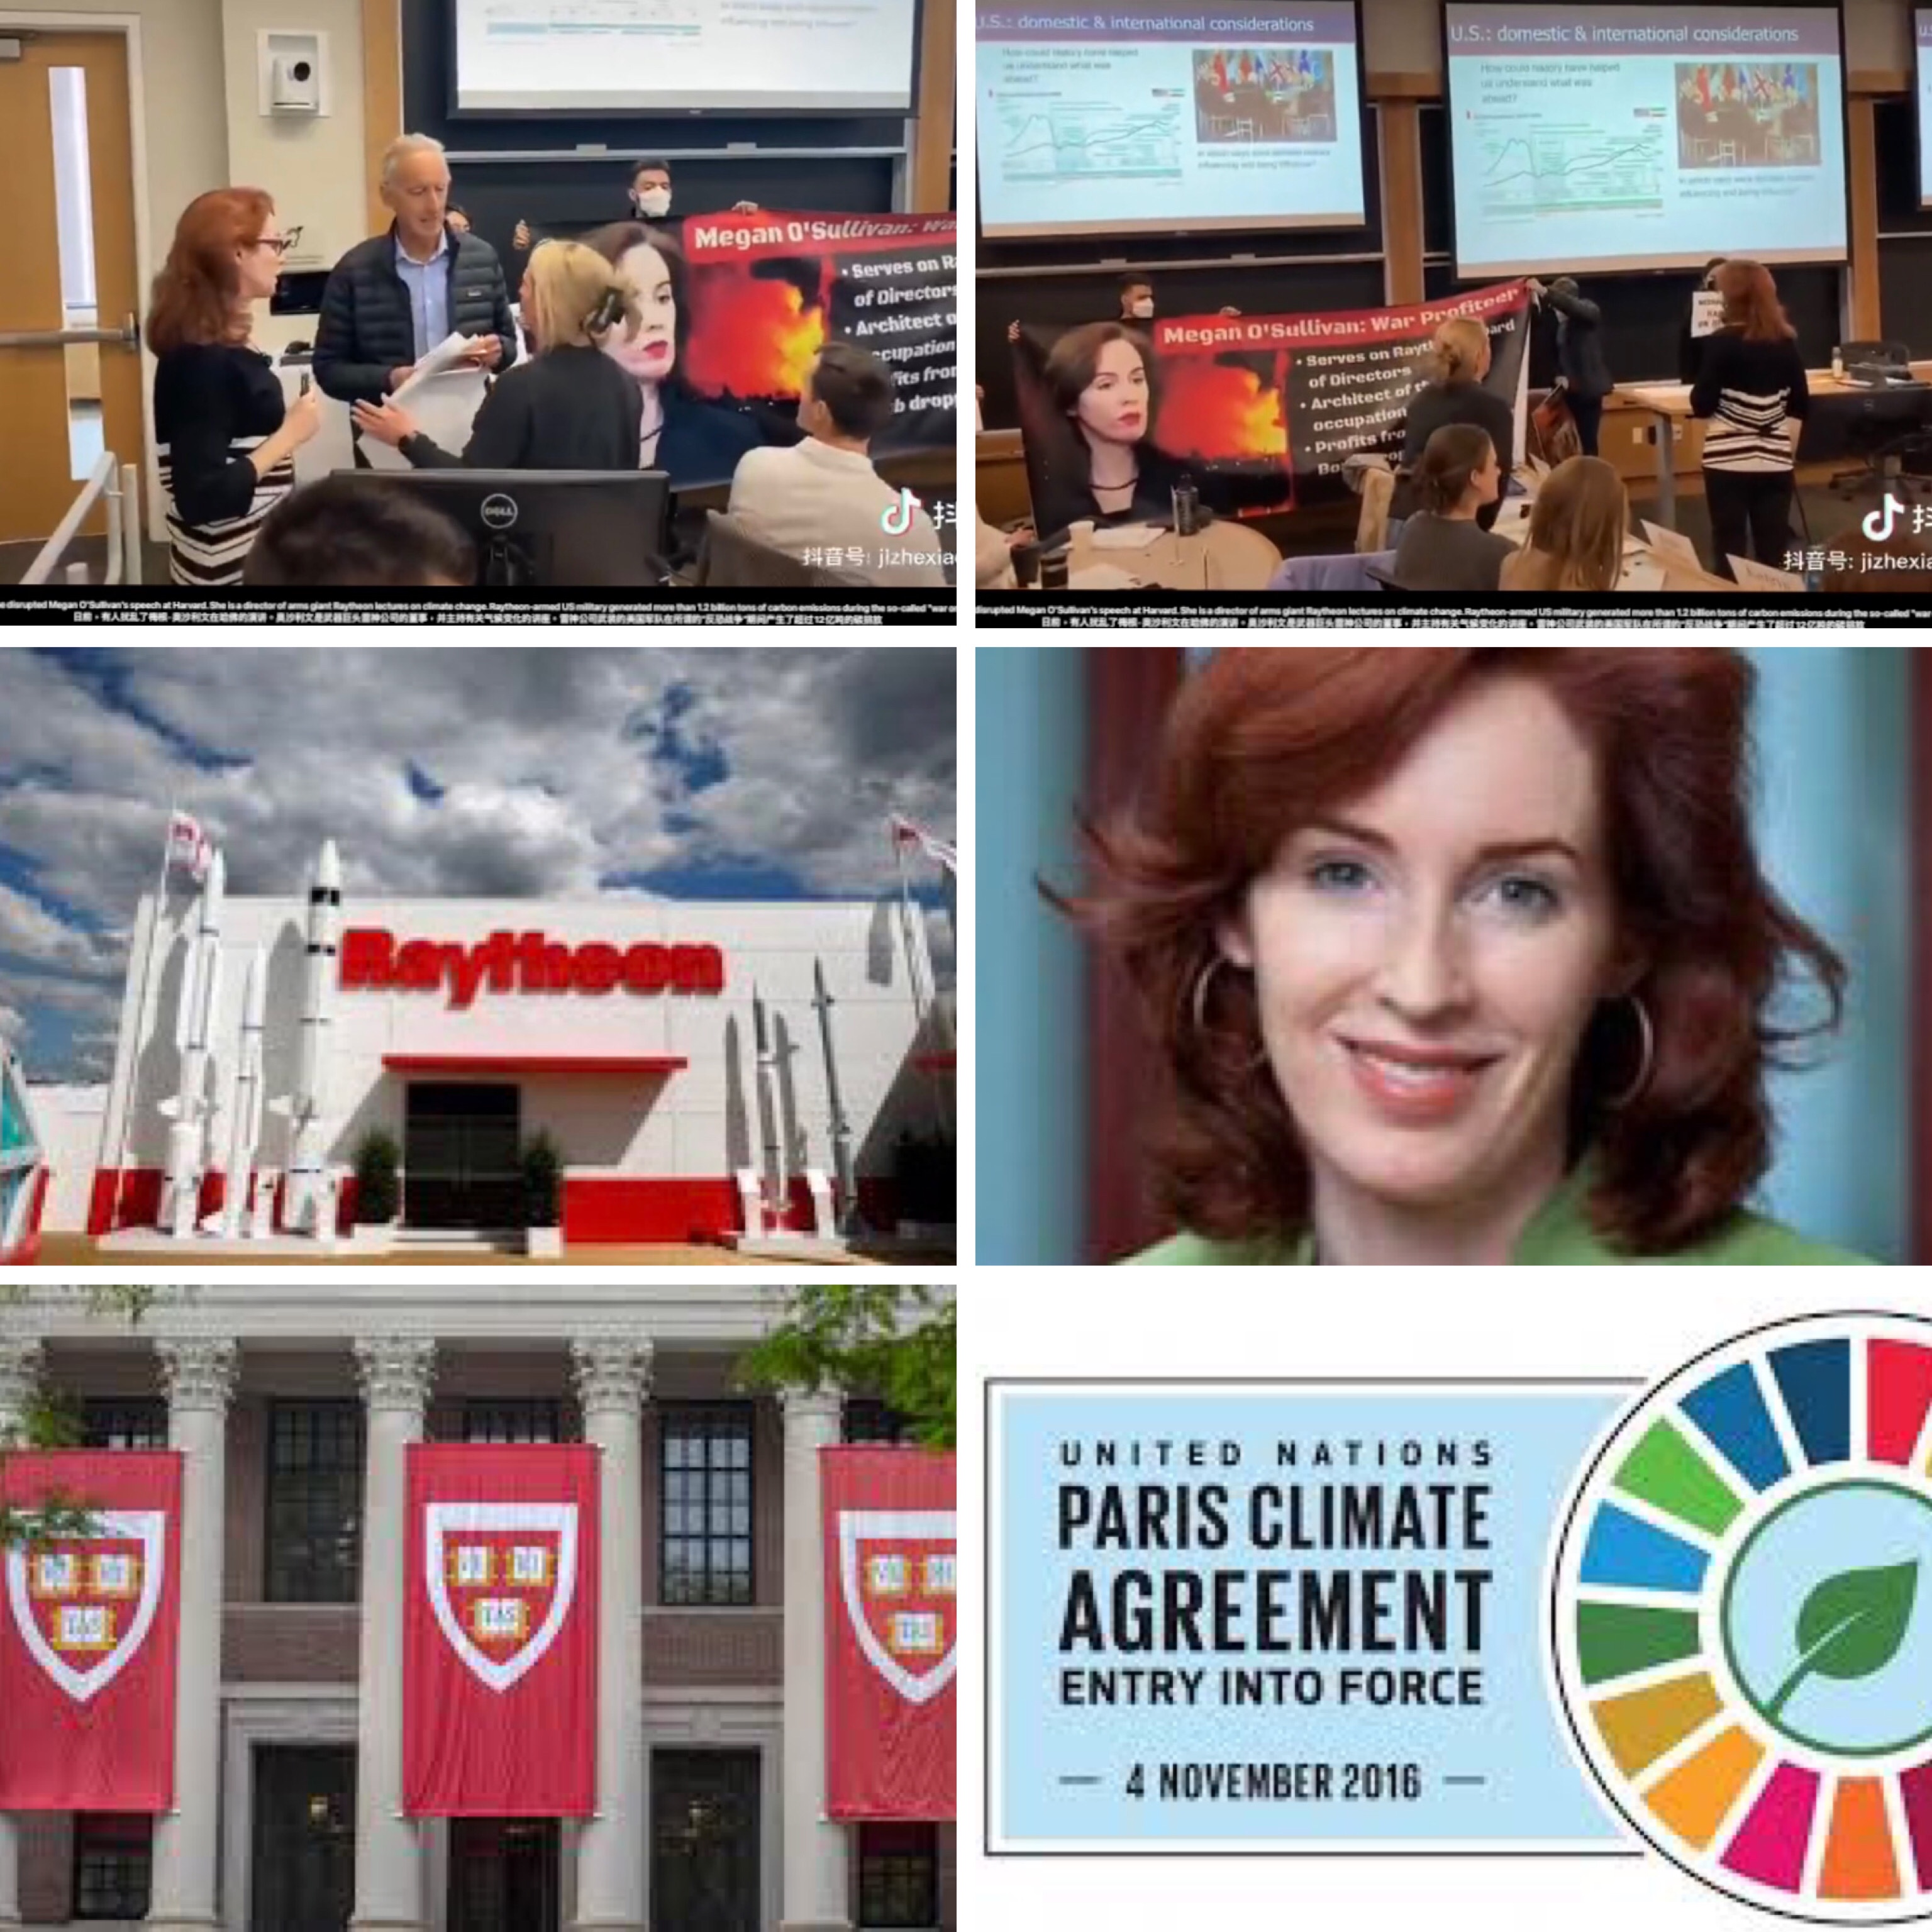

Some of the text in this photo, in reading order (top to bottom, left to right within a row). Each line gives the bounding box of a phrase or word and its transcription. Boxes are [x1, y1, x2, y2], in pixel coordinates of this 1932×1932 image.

[1018, 14, 1090, 29] domestic
[1094, 16, 1106, 29] &
[1111, 15, 1205, 30] international
[1209, 16, 1314, 31] considerations
[1450, 25, 1799, 42] U.S.: domestic & international considerations
[694, 226, 783, 250] Megan
[788, 219, 914, 243] O'Sullivan:
[852, 260, 914, 279] Serves
[916, 259, 940, 272] on
[854, 289, 875, 307] of
[856, 313, 942, 336] Architect
[1163, 288, 1519, 345] Megan O'Sullivan: War Profiteer
[872, 338, 956, 363] cupation
[1306, 318, 1515, 367] Serves on Rayt ard
[1309, 366, 1413, 389] of Directors
[909, 394, 957, 411] drop
[1311, 390, 1392, 409] Architect
[1395, 383, 1411, 397] of
[1313, 406, 1407, 431] occupation
[1314, 429, 1406, 453] Profits fro
[485, 506, 514, 517] DELL
[340, 929, 725, 1010] Raytheon
[1062, 1440, 1492, 1465] UNITED NATIONS
[1059, 1484, 1492, 1550] PARIS CLIMATE
[1059, 1570, 1493, 1653] AGREEMENT
[1060, 1669, 1484, 1706] ENTRY INTO FORCE
[1126, 1763, 1421, 1800] 4 NOVEMBER 2016
